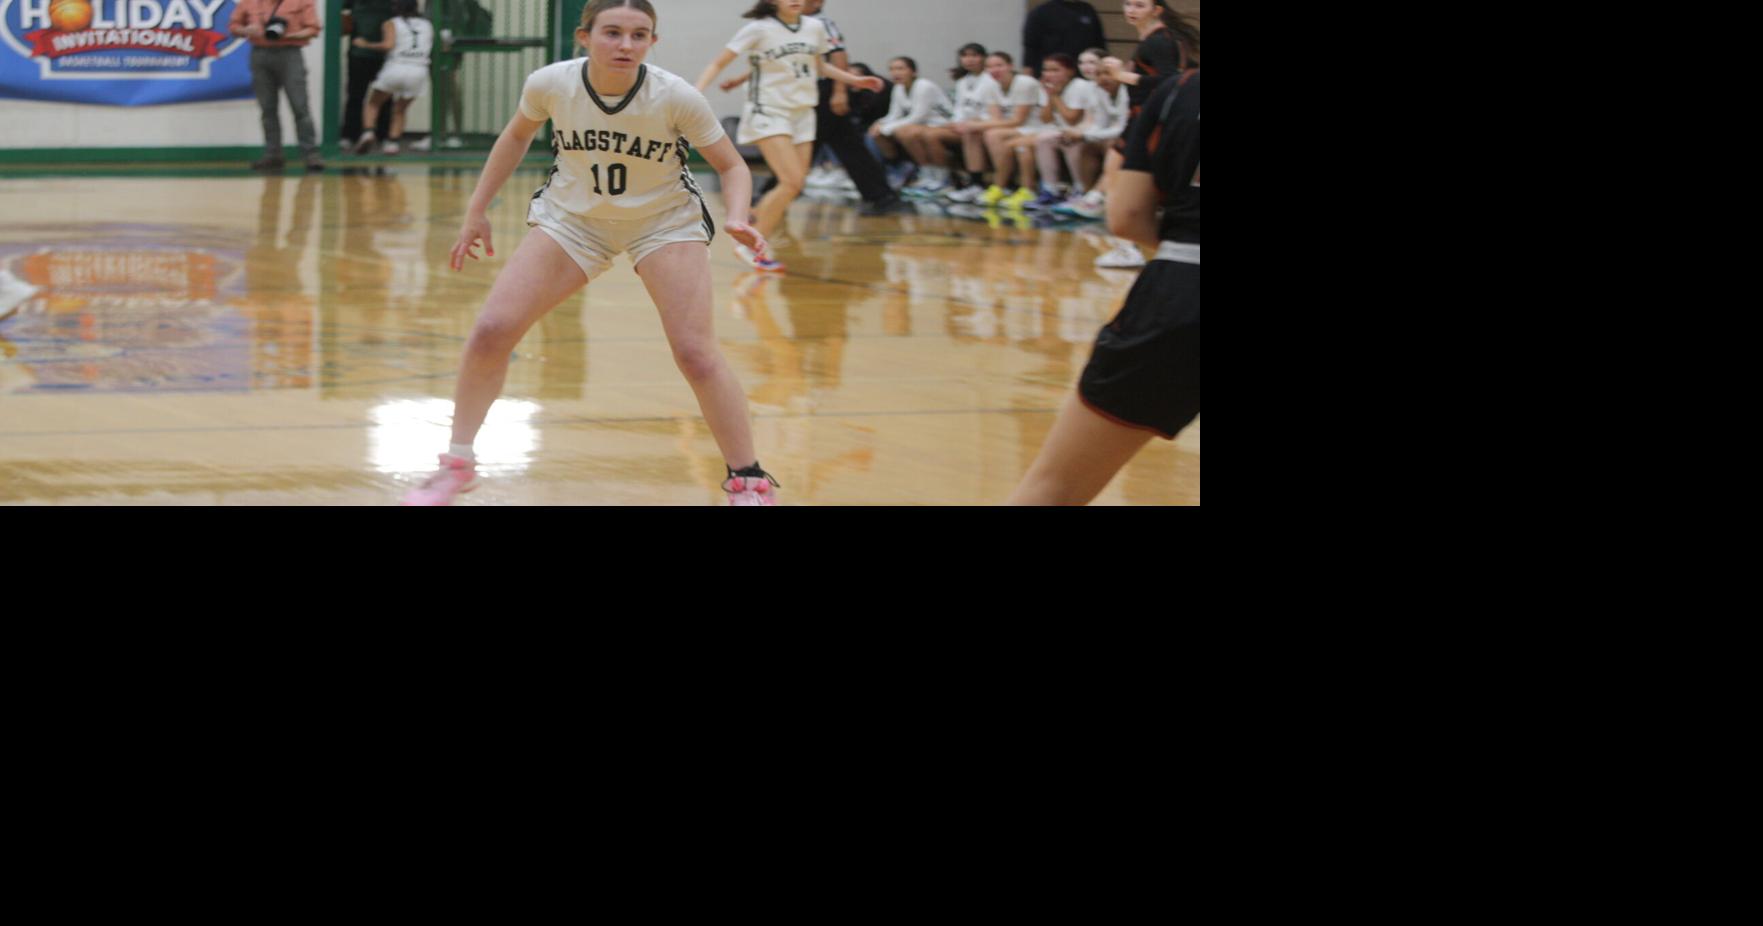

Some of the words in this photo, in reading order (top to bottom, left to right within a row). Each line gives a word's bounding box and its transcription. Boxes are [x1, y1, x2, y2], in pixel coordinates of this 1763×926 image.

[20, 0, 224, 30] HOLIDAY
[52, 29, 194, 52] INVITATIONAL
[556, 129, 673, 163] LAGSTAFF
[591, 163, 627, 196] 10
